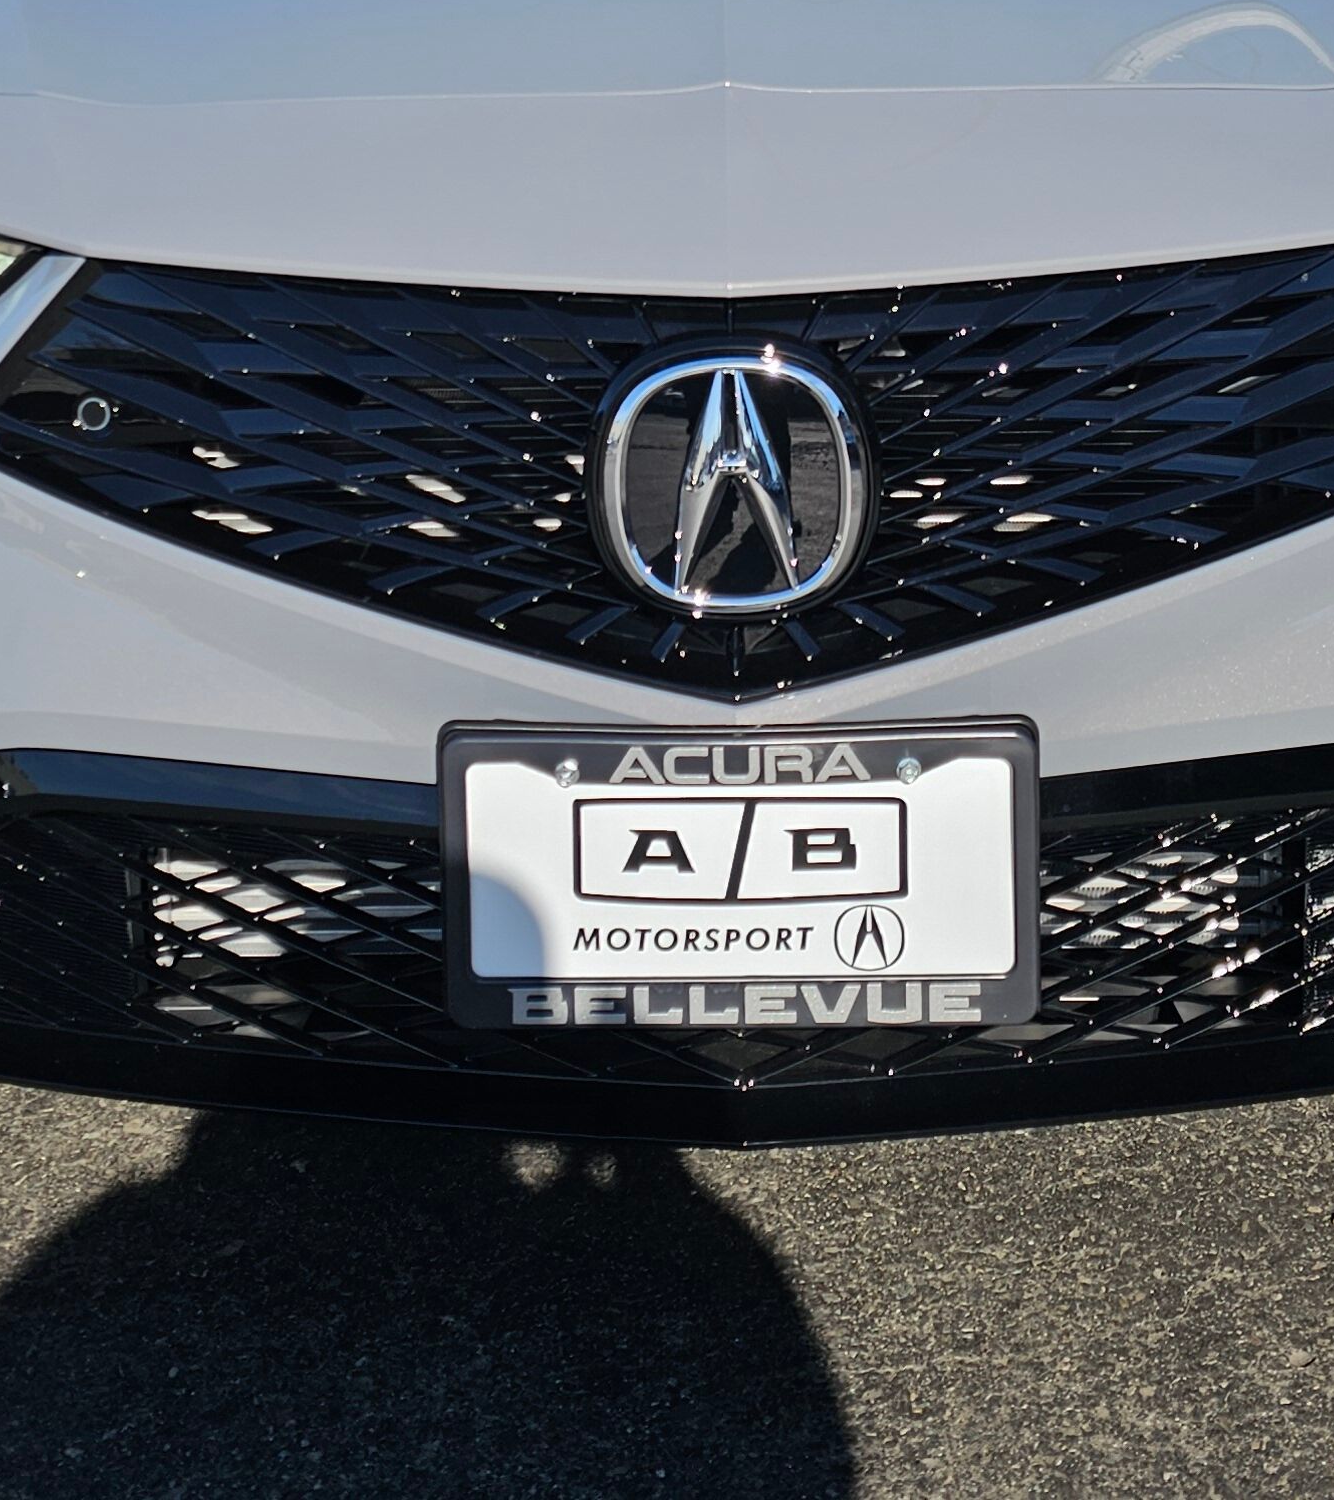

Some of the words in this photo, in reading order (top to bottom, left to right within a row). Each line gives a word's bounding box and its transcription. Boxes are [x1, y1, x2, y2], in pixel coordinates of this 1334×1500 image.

[609, 744, 871, 785] ACURA
[572, 926, 815, 954] MOTORSPORT
[508, 983, 982, 1025] BELLEVUE
